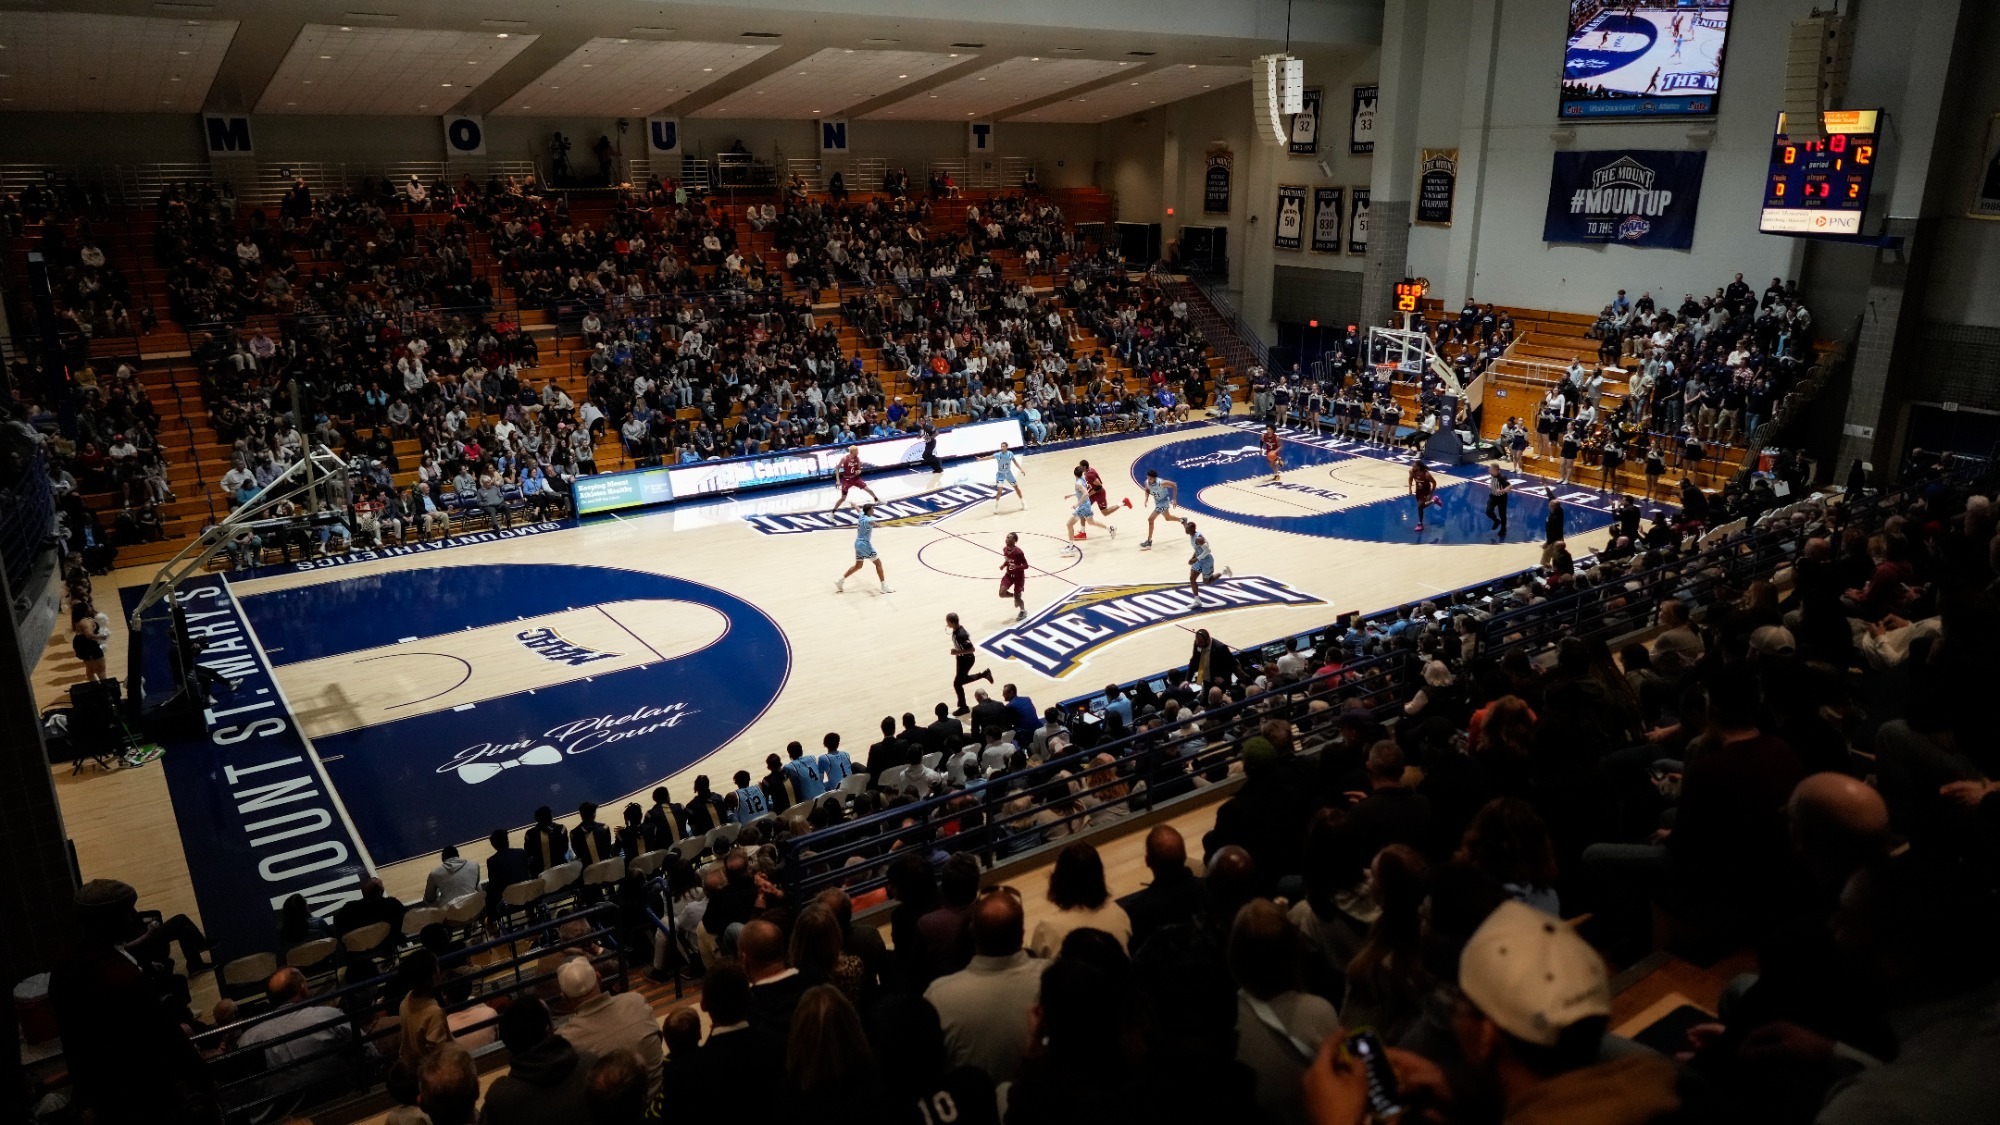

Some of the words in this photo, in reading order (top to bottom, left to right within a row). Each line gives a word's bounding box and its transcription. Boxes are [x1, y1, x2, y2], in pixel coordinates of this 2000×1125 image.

[1662, 73, 1701, 91] THE
[206, 118, 252, 151] M
[1299, 121, 1310, 132] 32
[1360, 119, 1372, 130] 33
[449, 119, 481, 151] O
[651, 121, 677, 150] U
[823, 122, 846, 149] N
[972, 124, 990, 149] T
[1809, 161, 1829, 169] period
[1836, 158, 1842, 171] 1
[1856, 146, 1872, 164] 12
[1596, 168, 1616, 187] THE
[1618, 167, 1652, 188] MOUNT
[1318, 190, 1339, 198] PHELAN
[1849, 184, 1859, 198] 2
[1570, 189, 1672, 216] #MOUNTUP
[1284, 216, 1295, 228] 50
[1319, 219, 1335, 230] 830
[1588, 222, 1598, 234] TO
[1598, 222, 1614, 234] THE
[1829, 217, 1855, 228] PNC
[1399, 295, 1415, 311] 29
[578, 482, 606, 492] Keeping
[606, 479, 629, 487] Mount
[579, 490, 607, 499] Athletes
[607, 486, 633, 495] Healthy
[1256, 481, 1349, 501] MAAC
[991, 612, 1115, 671] THE
[1087, 577, 1307, 628] MOUNT
[515, 626, 627, 667] MAAC
[203, 687, 288, 746] ST.
[436, 739, 537, 773] Jim
[543, 702, 689, 743] Phelan
[566, 709, 702, 755] Court
[807, 766, 819, 782] 4
[745, 795, 765, 815] 12
[223, 755, 365, 926] MOUNT
[916, 1090, 959, 1125] 10
